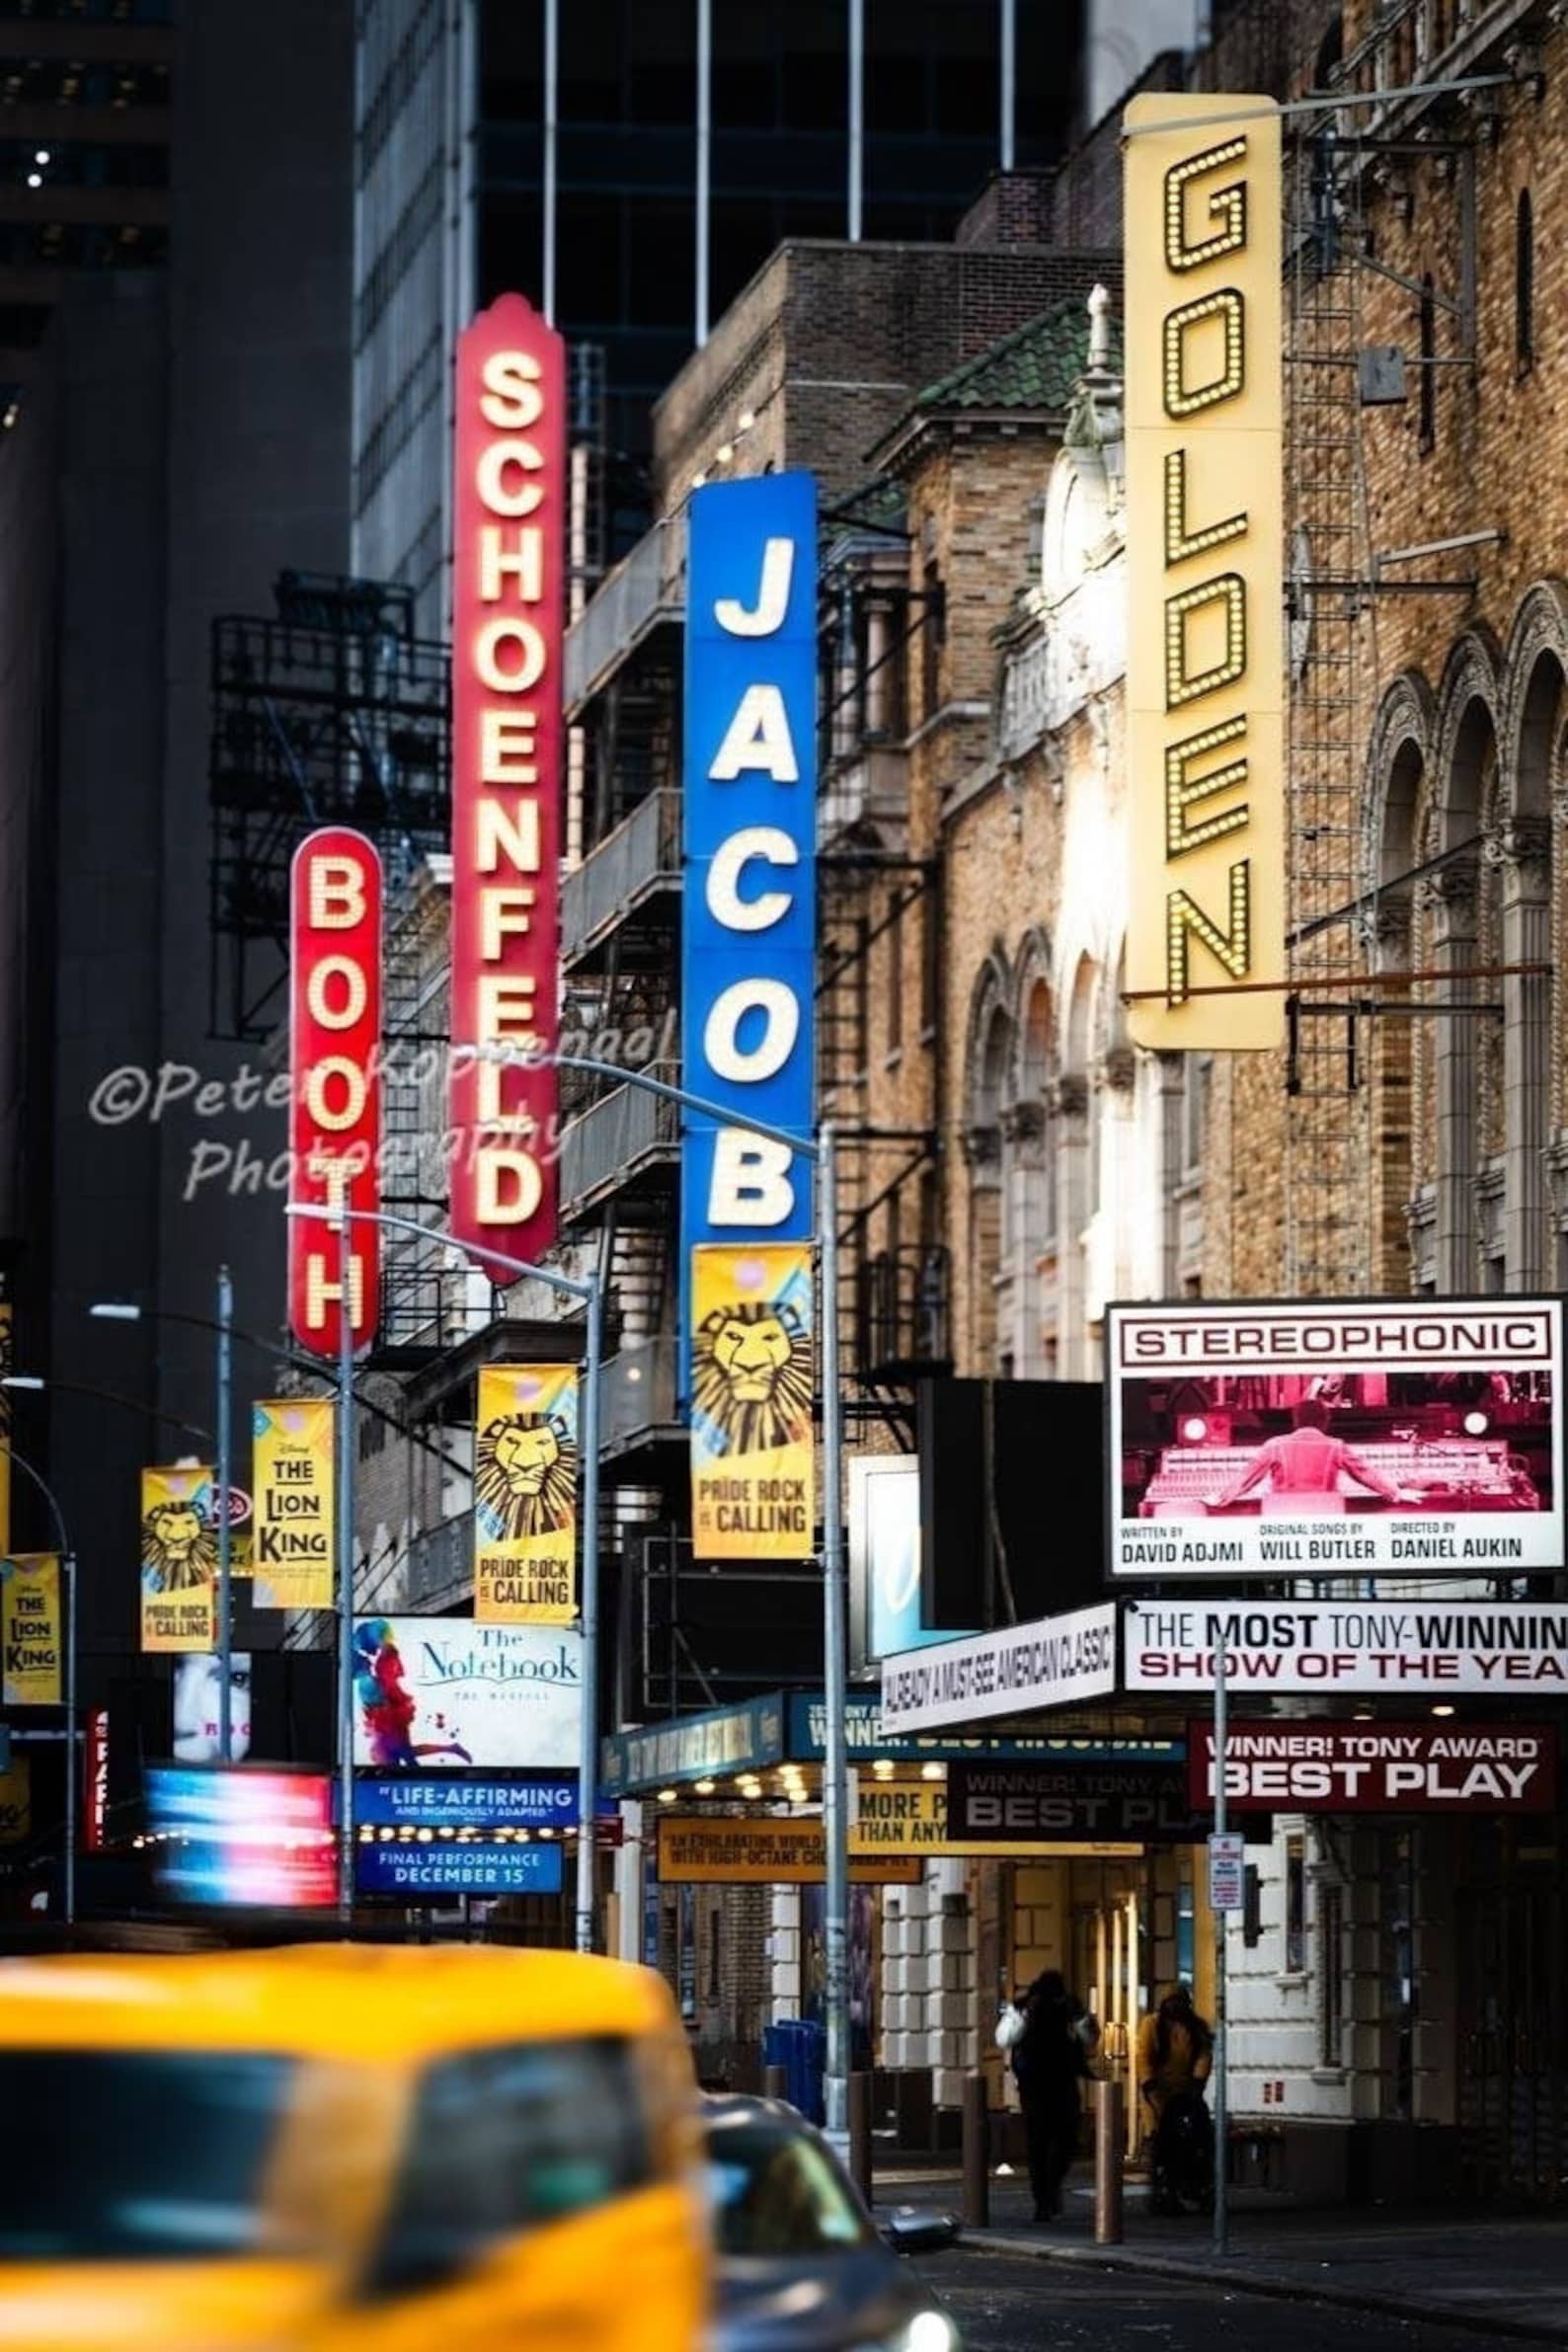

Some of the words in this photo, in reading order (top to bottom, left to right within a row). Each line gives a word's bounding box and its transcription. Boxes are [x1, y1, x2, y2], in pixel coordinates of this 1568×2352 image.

[1163, 133, 1252, 1013] GOLDEN
[475, 350, 549, 1226] SCHOENFELD
[703, 537, 801, 1228] JACOB
[306, 855, 367, 1330] BOOTH
[1134, 1321, 1538, 1357] STEREOPHONIC
[274, 1460, 314, 1479] THE
[699, 1479, 751, 1502] PRIDE
[757, 1479, 806, 1502] ROCK
[717, 1505, 807, 1533] CALLING
[1259, 1524, 1307, 1536] ORIGINAL
[1310, 1524, 1343, 1535] SONGS
[1346, 1523, 1363, 1535] BY
[1390, 1522, 1440, 1534] DIRECTED
[1442, 1522, 1456, 1533] BY
[1121, 1527, 1167, 1539] WRITTEN
[1169, 1527, 1184, 1538] BY
[1122, 1543, 1177, 1563] DAVID
[1183, 1541, 1243, 1562] ADJMI
[1260, 1540, 1303, 1560] WILL
[1308, 1539, 1376, 1560] BUTLER
[1390, 1538, 1457, 1559] DANIEL
[1461, 1537, 1523, 1558] AUKIN
[480, 1558, 524, 1578] PRIDE
[528, 1559, 569, 1579] ROCK
[16, 1597, 44, 1611] THE
[494, 1580, 570, 1605] CALLING
[180, 1605, 208, 1618] ROCK
[156, 1619, 209, 1638] CALLING
[477, 1630, 522, 1647] The
[1139, 1612, 1195, 1648] THE
[1206, 1613, 1318, 1648] MOST
[422, 1641, 579, 1678] Notebook
[943, 1651, 995, 1701] MUST-SEE
[995, 1637, 1058, 1691] AMERICAN
[1139, 1652, 1283, 1679] SHOW
[1295, 1653, 1358, 1679] OF
[1370, 1654, 1459, 1679] THE
[1207, 1736, 1333, 1758] WINNER!
[1340, 1737, 1423, 1758] TONY
[1428, 1737, 1539, 1759] AWARD
[1208, 1762, 1372, 1798] BEST
[1384, 1763, 1540, 1799] PLAY
[859, 1792, 921, 1819] MORE
[965, 1796, 1108, 1828] BEST
[858, 1822, 904, 1842] THAN
[378, 1852, 424, 1865] FINAL
[428, 1852, 540, 1866] PERFORMANCE
[395, 1868, 498, 1883] DECEMBER
[505, 1868, 524, 1883] 15
